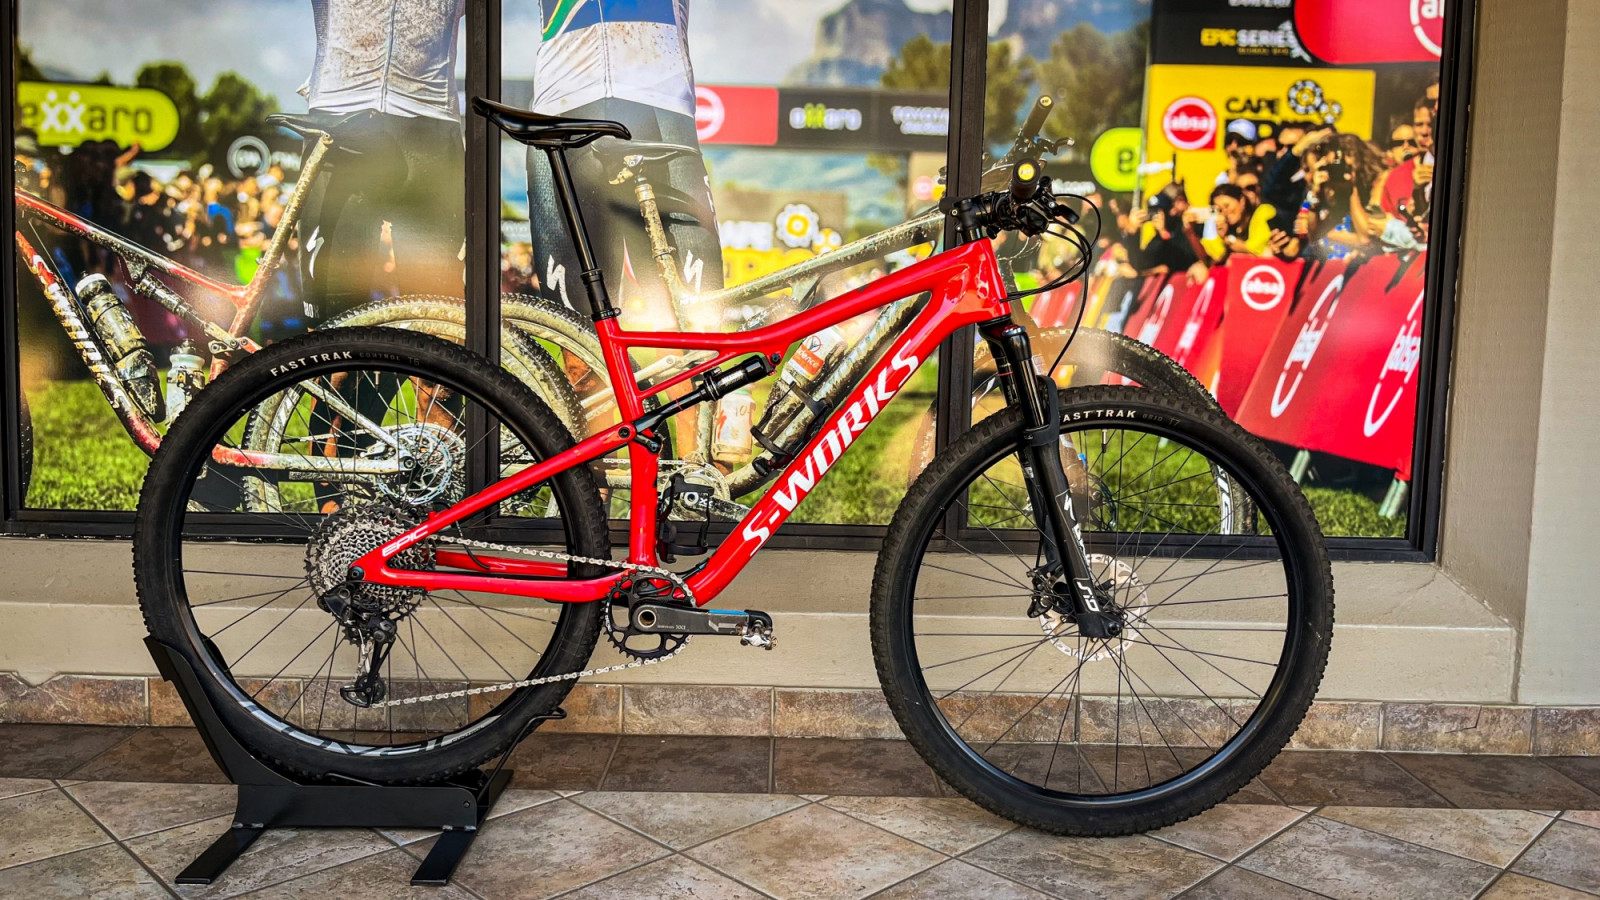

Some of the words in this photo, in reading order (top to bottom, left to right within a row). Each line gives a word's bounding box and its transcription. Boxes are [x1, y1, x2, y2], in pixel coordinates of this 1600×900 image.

[21, 90, 152, 134] exxaro
[1226, 97, 1279, 115] CAPE
[270, 358, 306, 377] FAST
[310, 351, 353, 363] TRAK
[1059, 411, 1092, 423] AST
[1095, 409, 1136, 418] TRAK
[742, 339, 919, 558] S-WORKS
[382, 525, 429, 557] EPIC
